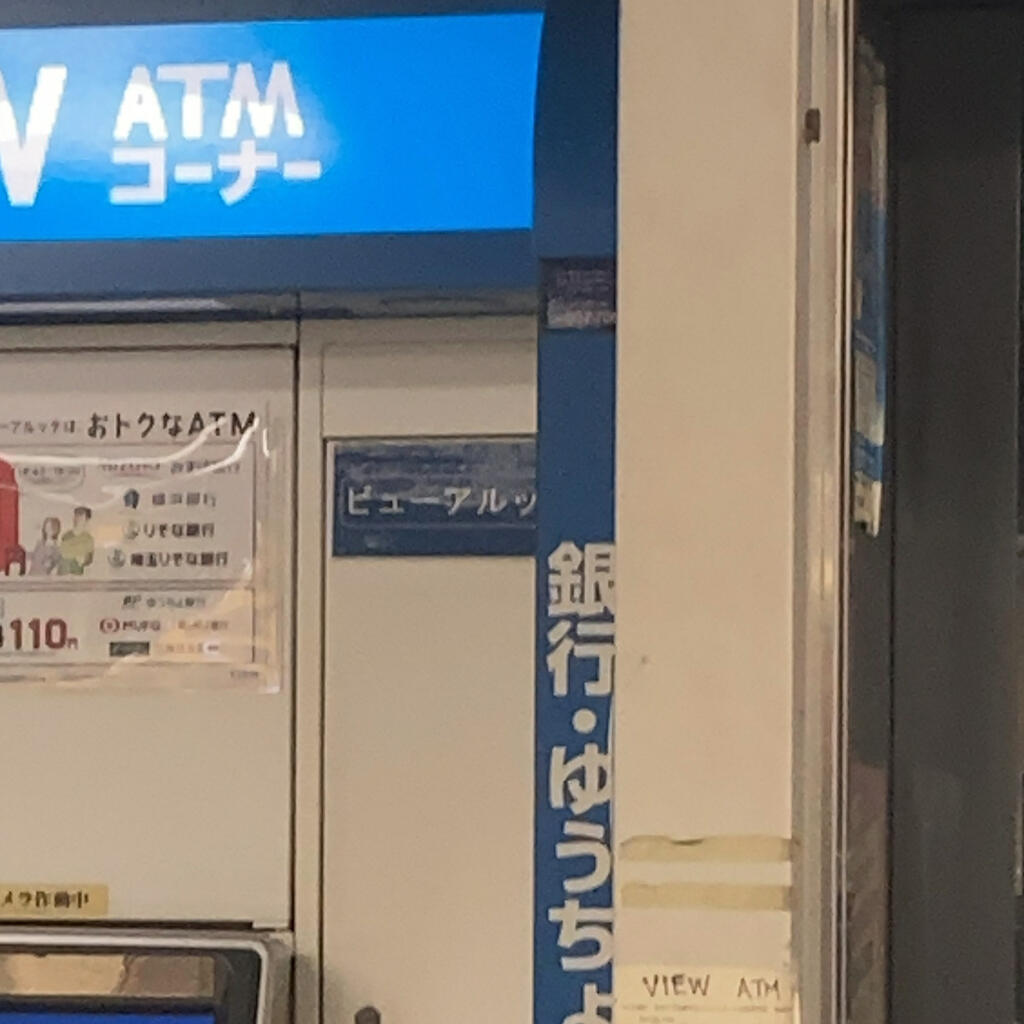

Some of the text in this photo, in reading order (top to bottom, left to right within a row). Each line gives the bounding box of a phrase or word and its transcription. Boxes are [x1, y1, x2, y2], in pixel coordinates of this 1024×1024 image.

[113, 61, 305, 141] ATM
[109, 141, 323, 206] コーナー
[88, 411, 256, 438] おトクなATM
[347, 485, 536, 516] ビューアルッ
[642, 973, 780, 999] VIEW ATM
